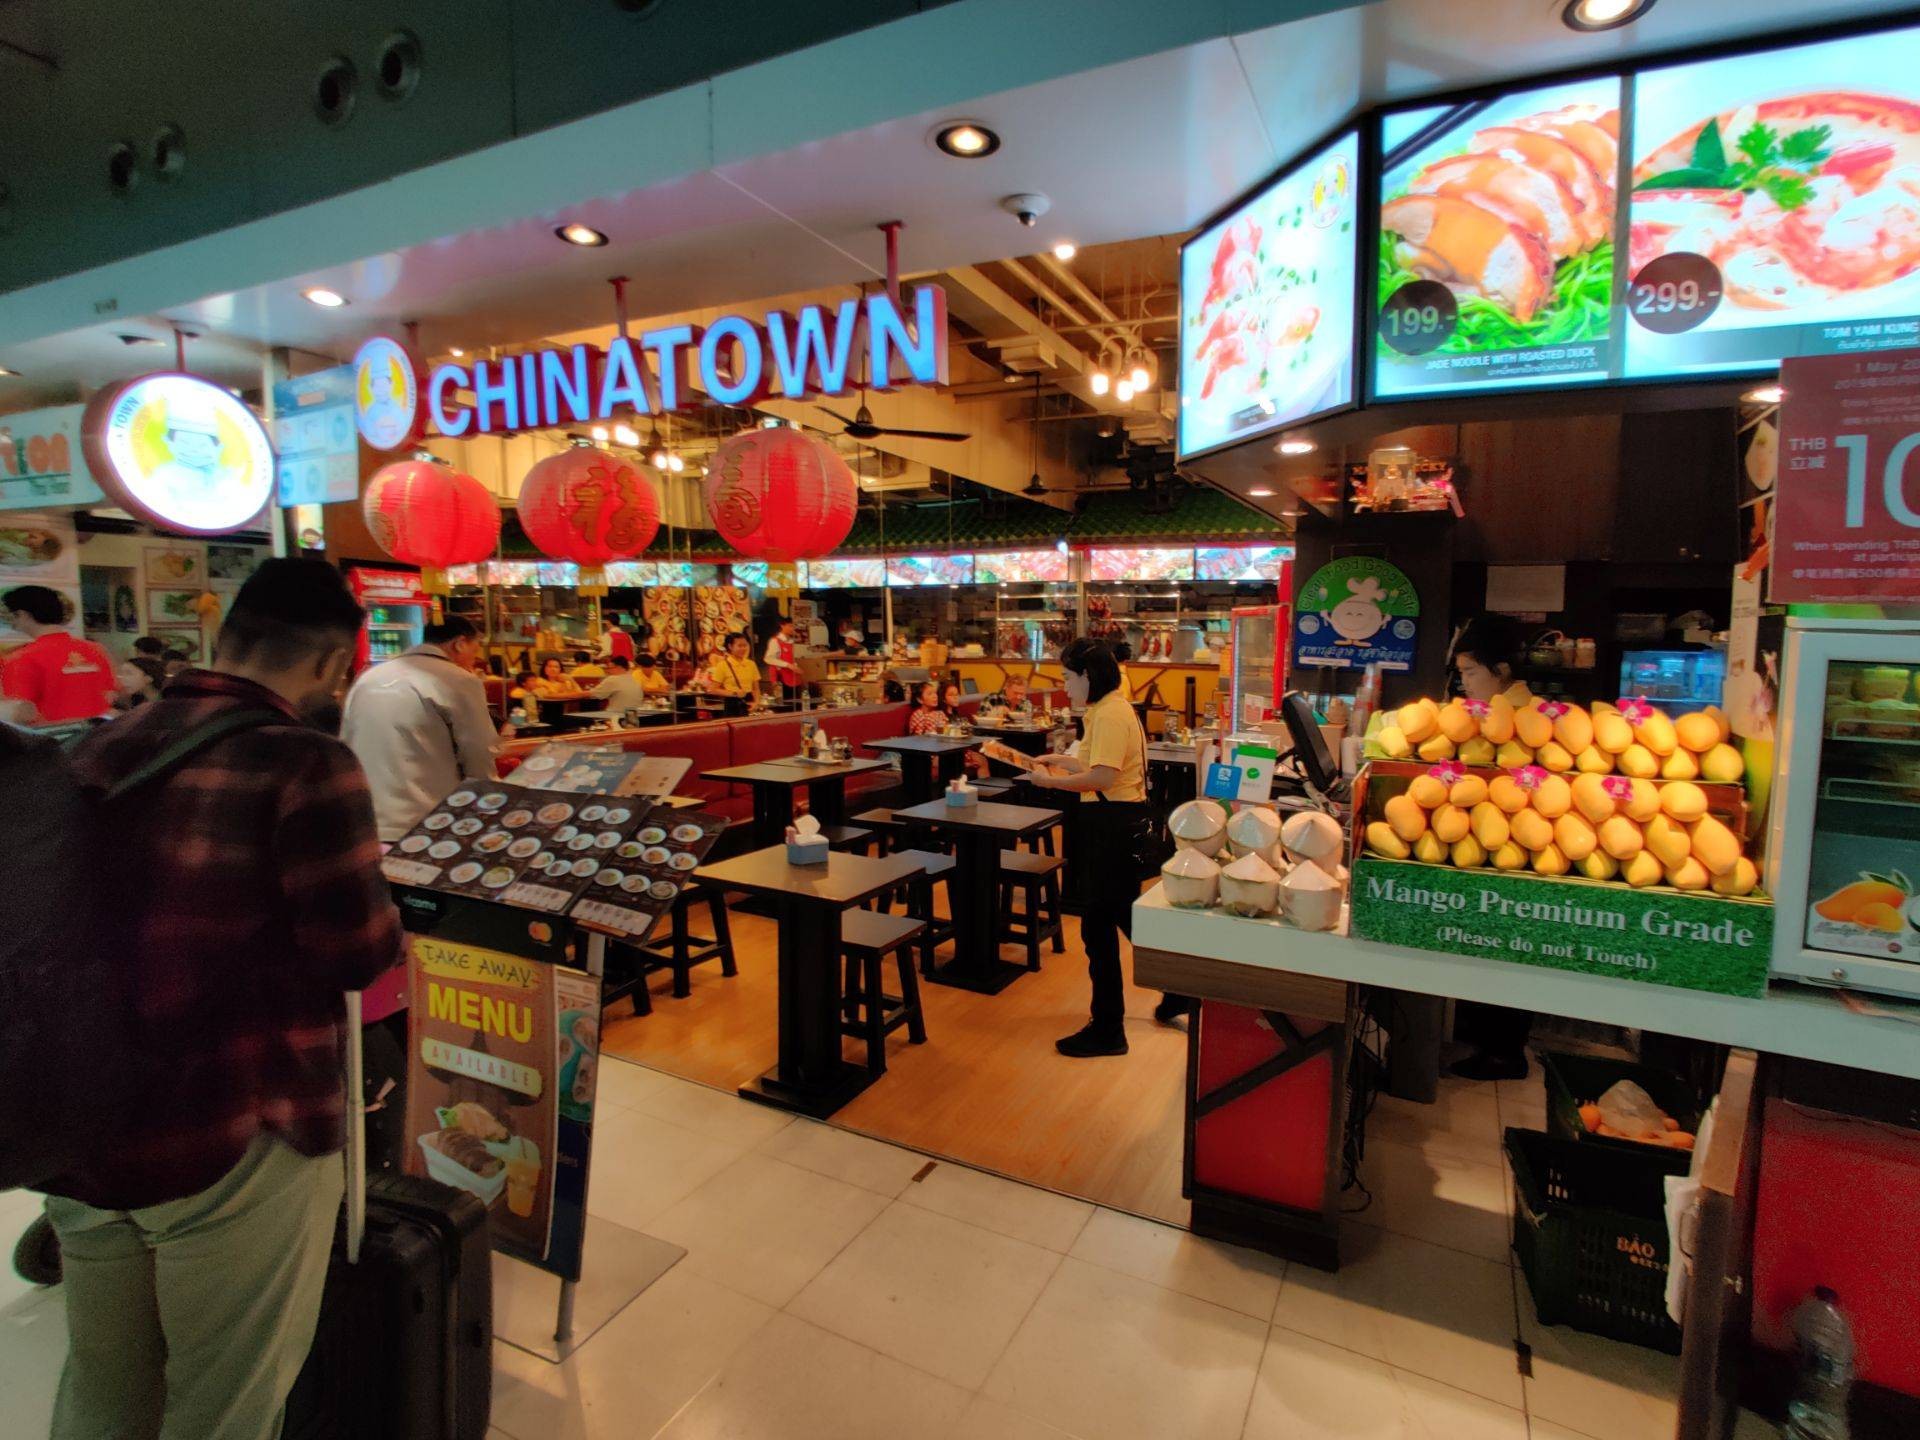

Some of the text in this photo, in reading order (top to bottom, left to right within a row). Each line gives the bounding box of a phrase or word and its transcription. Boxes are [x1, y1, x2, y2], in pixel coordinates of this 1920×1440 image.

[1635, 280, 1720, 314] 299.-
[1387, 305, 1457, 337] 199.-
[428, 286, 940, 438] CHINATOWN
[1567, 346, 1596, 358] DUCK
[1788, 437, 1827, 451] THB
[1832, 540, 1889, 553] spending
[1301, 575, 1326, 610] Clean
[1326, 559, 1359, 579] Food
[1364, 558, 1399, 583] Good
[1366, 875, 1756, 948] Mango Premium Grade
[422, 944, 534, 988] TAKE AWAY
[1435, 924, 1657, 972] (Please do not Touch)
[428, 982, 532, 1044] MENU
[431, 1045, 530, 1087] AVAILABLE
